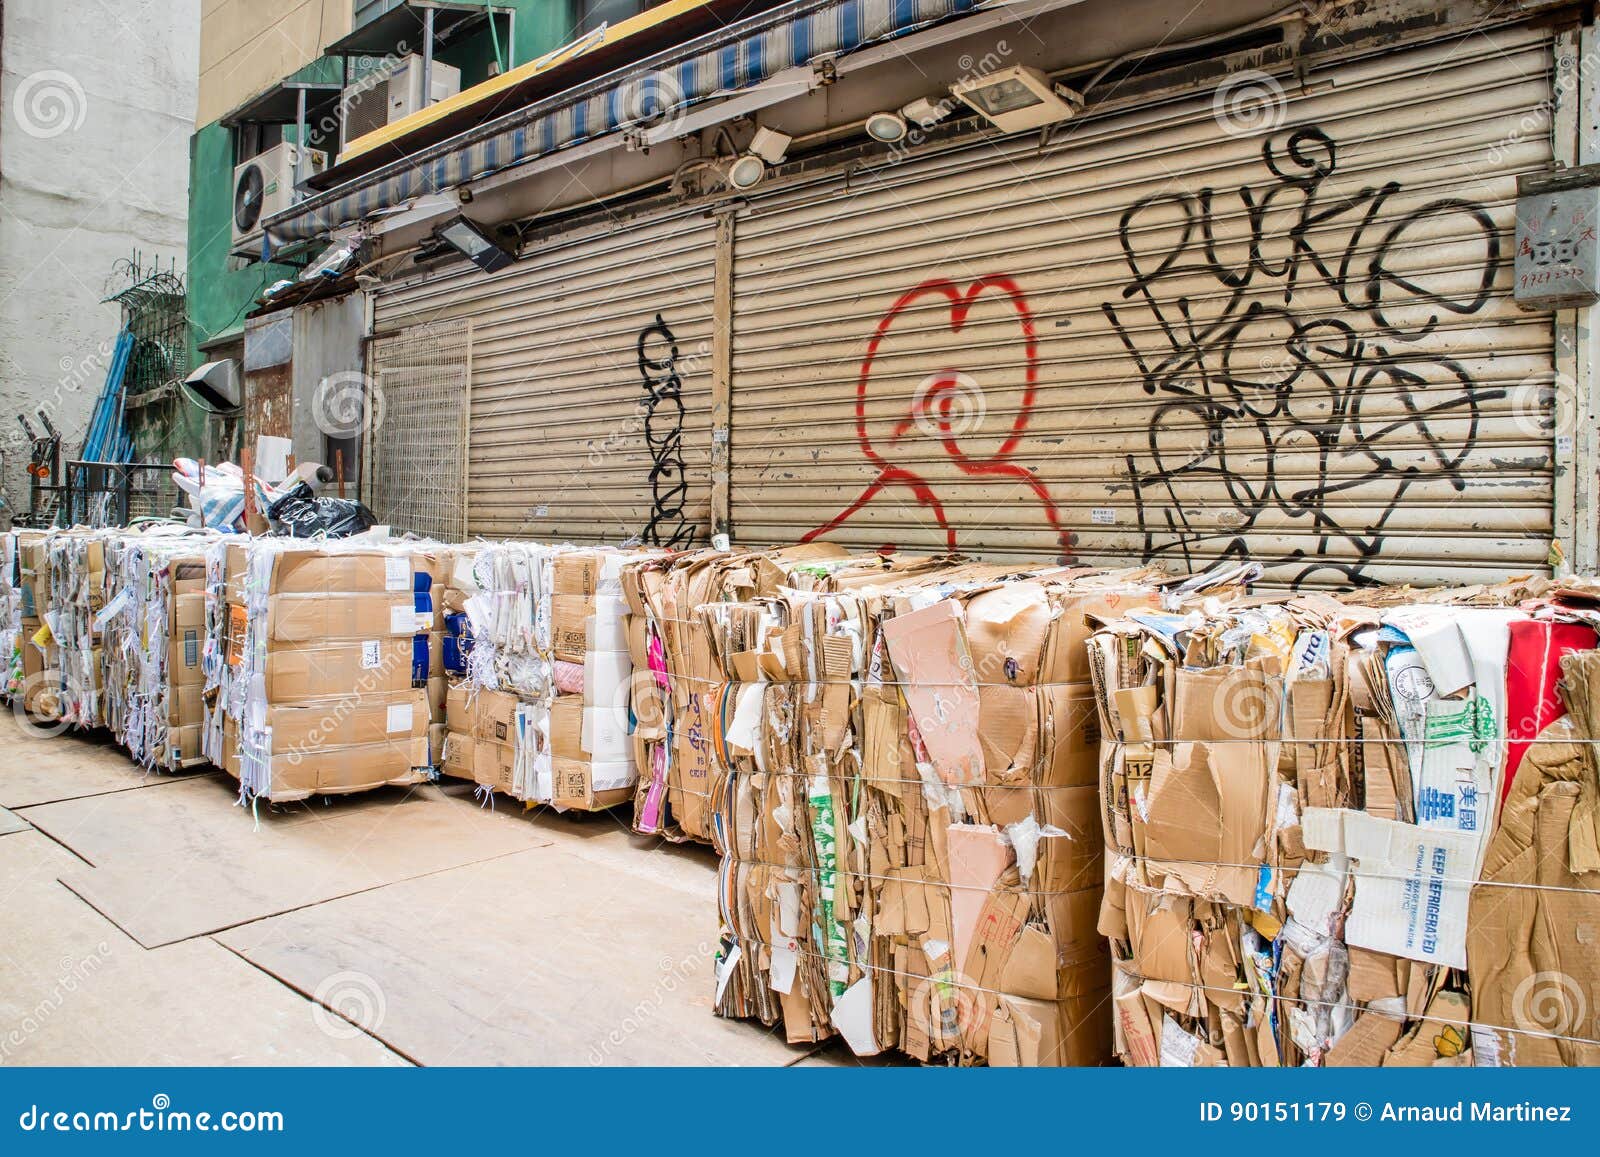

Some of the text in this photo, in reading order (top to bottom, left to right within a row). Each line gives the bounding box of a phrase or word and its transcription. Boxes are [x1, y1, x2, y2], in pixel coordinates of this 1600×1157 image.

[1458, 785, 1478, 831] 美國
[1411, 872, 1422, 903] SORAGE
[1421, 847, 1447, 955] KEEP REFRIGERATED
